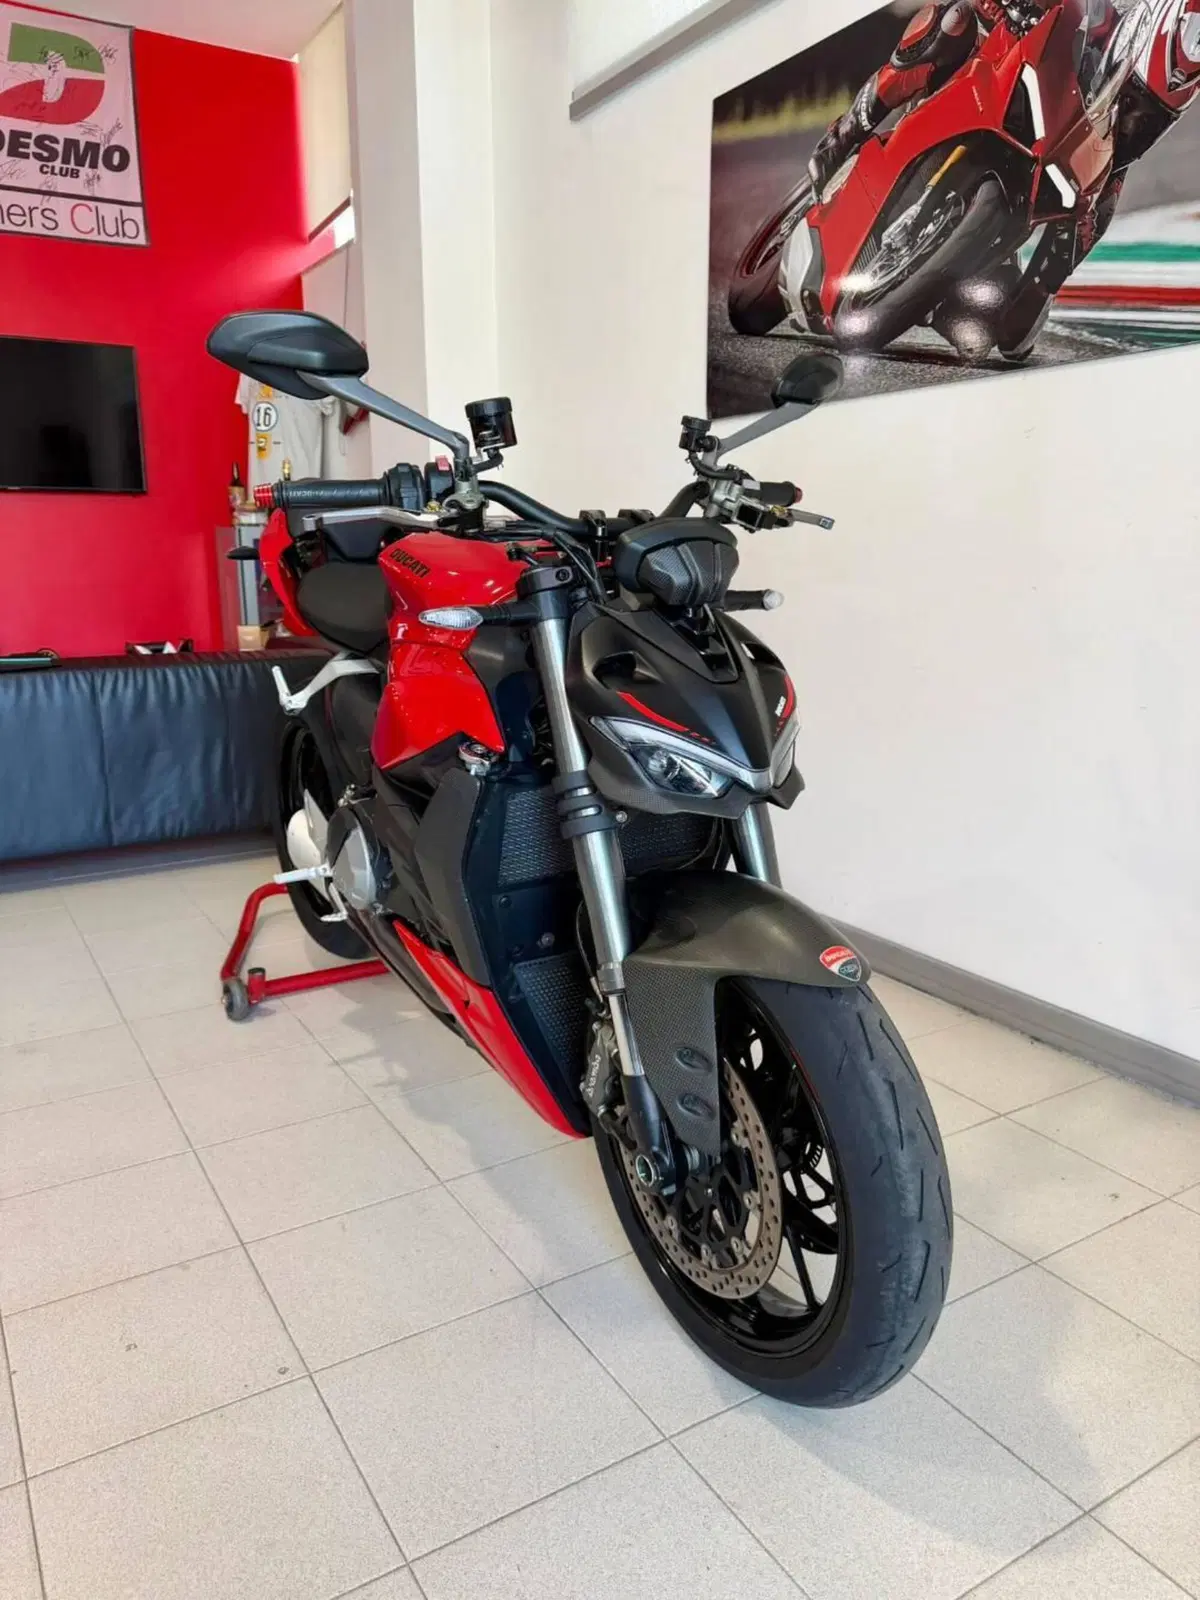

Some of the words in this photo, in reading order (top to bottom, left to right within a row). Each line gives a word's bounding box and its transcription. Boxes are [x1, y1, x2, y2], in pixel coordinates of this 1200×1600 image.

[0, 129, 130, 172] ESMO
[39, 163, 80, 179] CLUB
[70, 203, 140, 240] Club
[256, 406, 272, 427] 16
[390, 548, 431, 578] DUCATI
